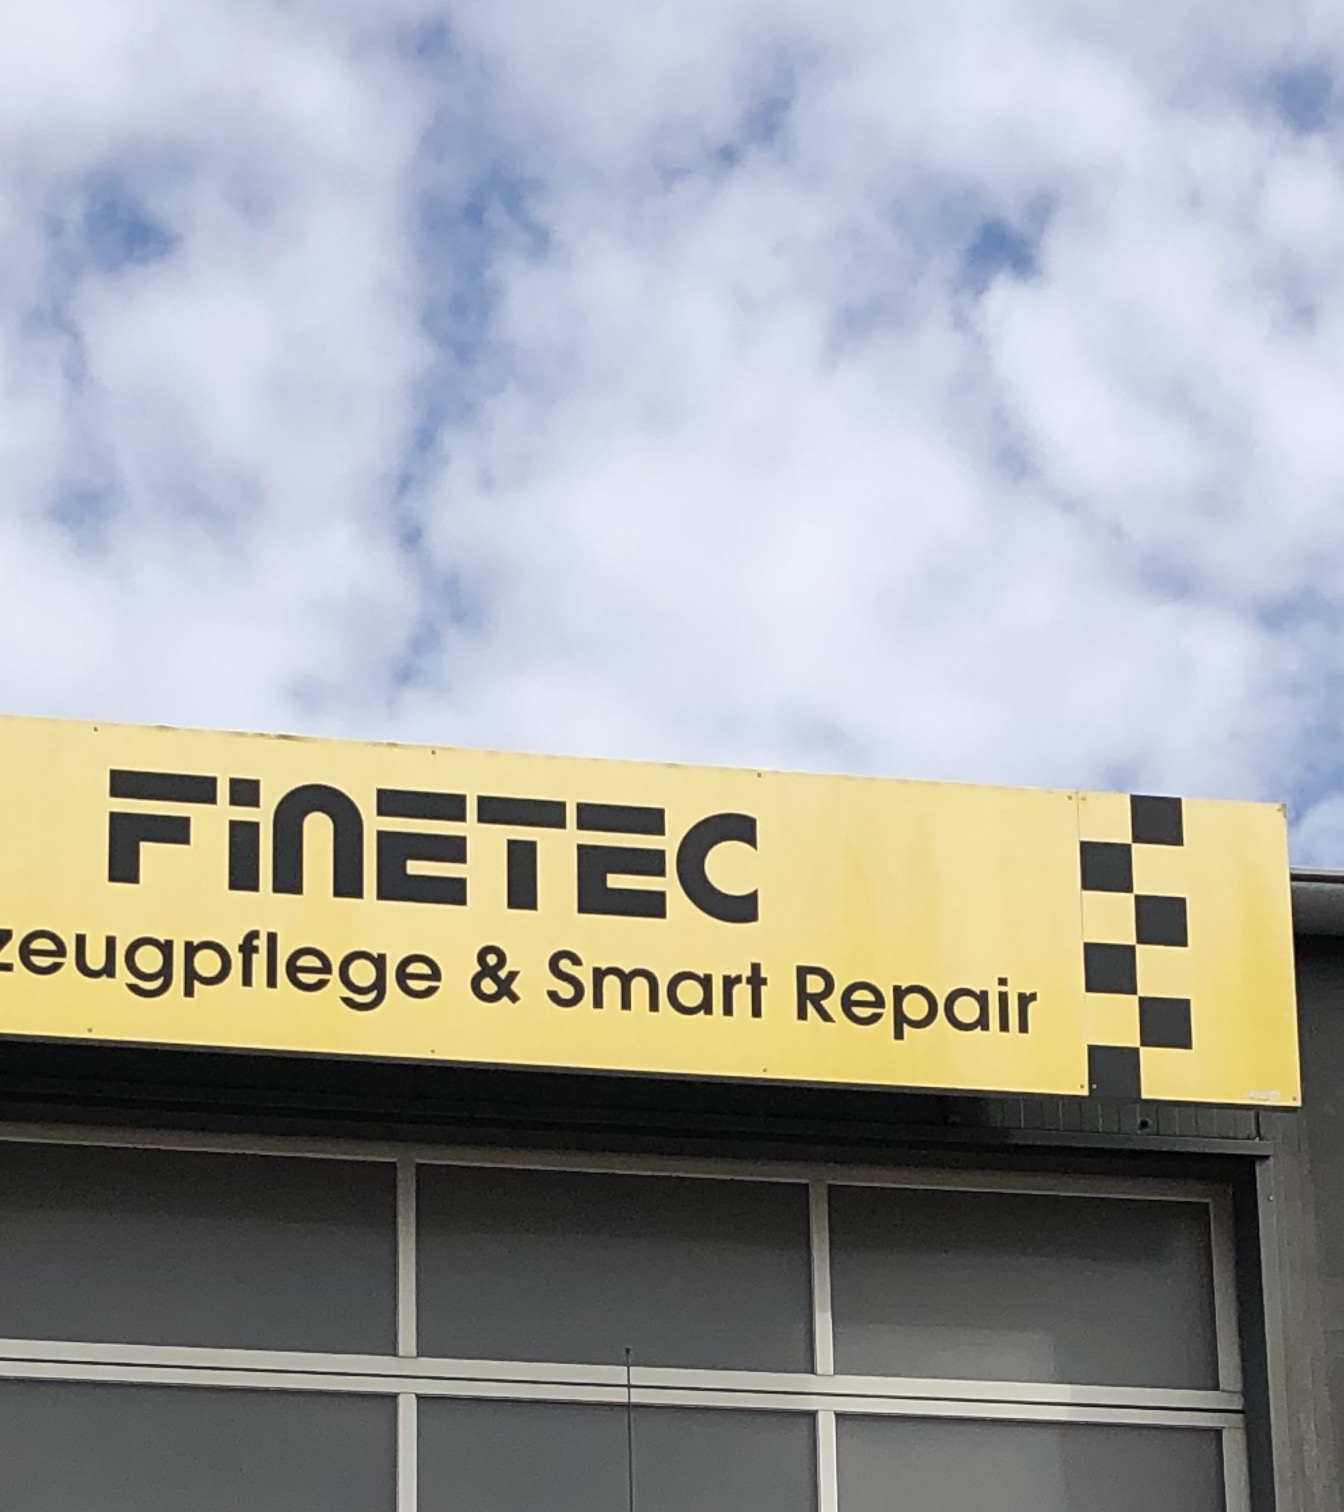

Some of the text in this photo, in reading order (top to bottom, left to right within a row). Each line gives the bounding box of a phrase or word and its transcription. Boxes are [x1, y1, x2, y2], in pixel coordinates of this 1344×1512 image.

[469, 944, 521, 1004] &
[546, 949, 768, 1019] Smart
[796, 965, 1038, 1040] Repair
